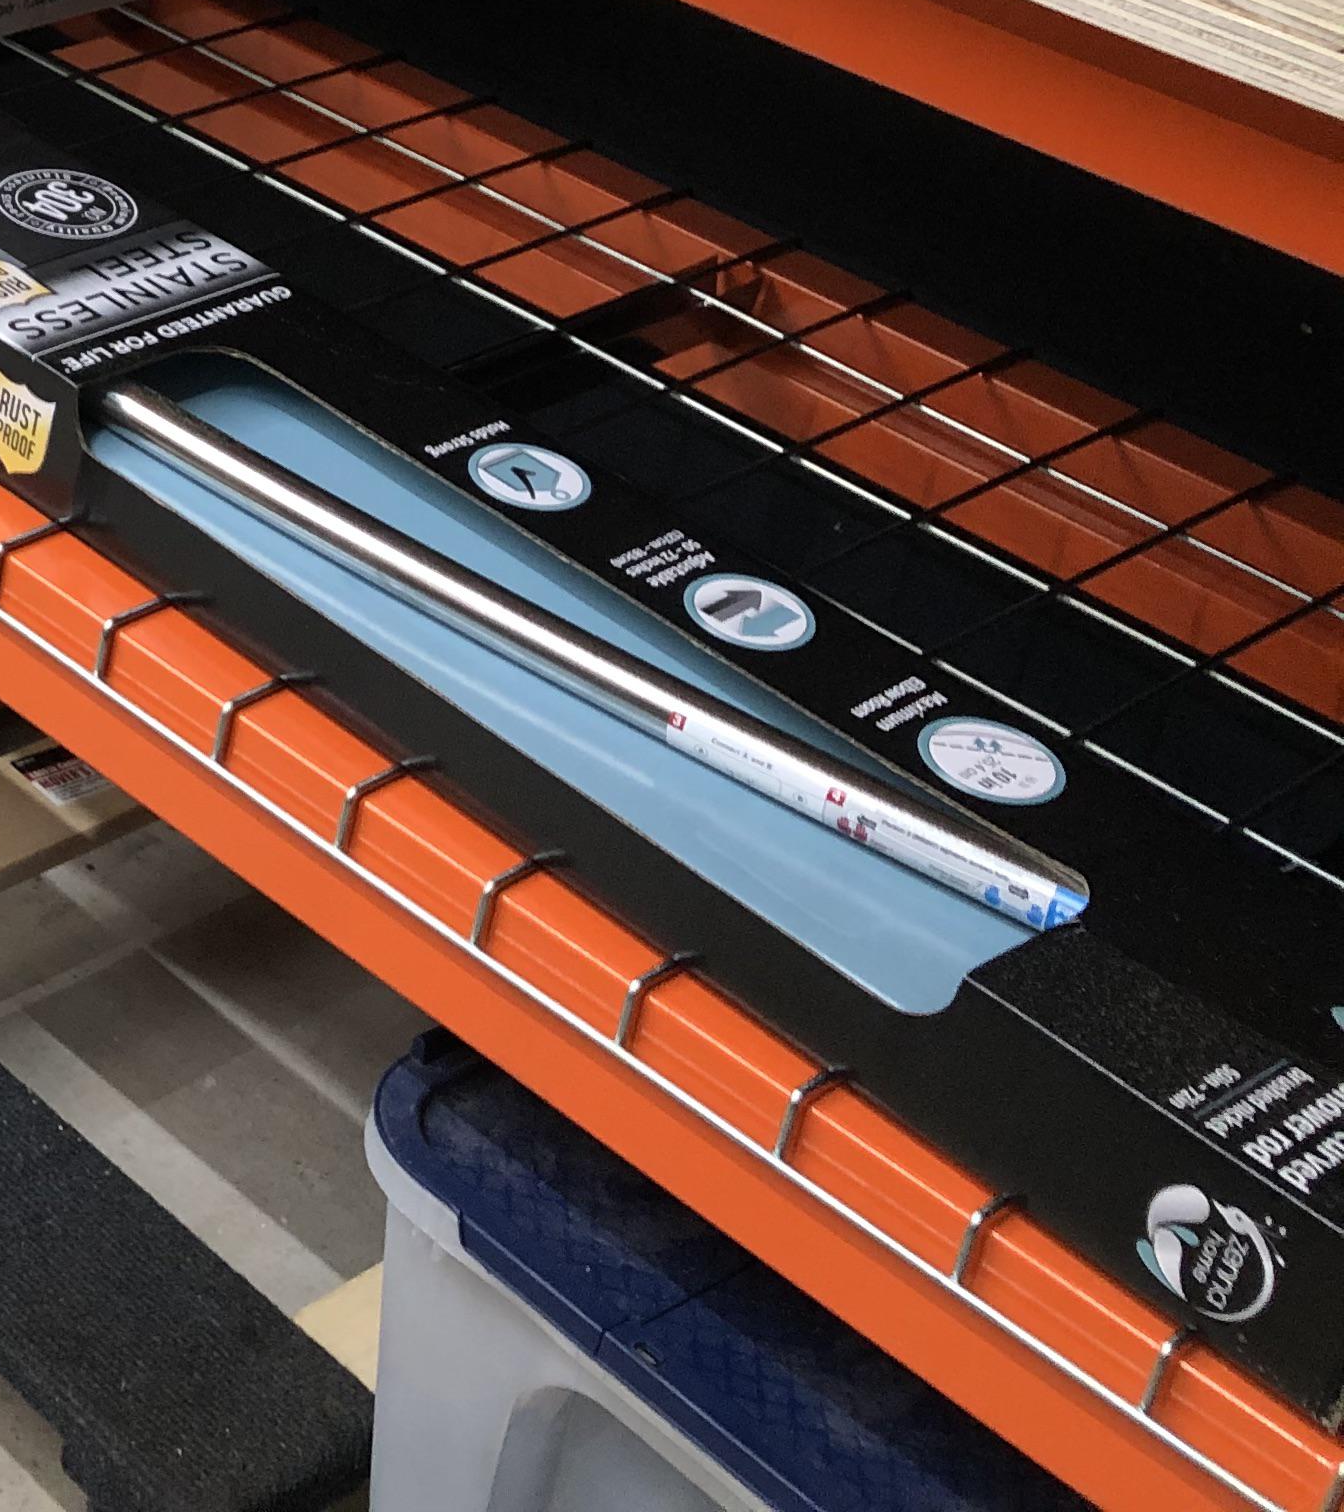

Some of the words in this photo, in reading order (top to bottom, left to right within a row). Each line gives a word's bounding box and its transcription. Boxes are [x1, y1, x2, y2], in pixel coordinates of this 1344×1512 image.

[22, 181, 95, 222] 304
[46, 223, 114, 236] Quality
[70, 230, 212, 281] STEEL
[7, 252, 248, 341] STAINLESS
[156, 285, 292, 338] GUARANTEED
[109, 330, 158, 355] FOR
[424, 434, 474, 458] Strong
[469, 420, 511, 440] Holds
[646, 550, 716, 588] Adjustable
[850, 693, 892, 719] Room
[883, 676, 927, 702] Elbow
[875, 690, 949, 732] Maximum
[992, 767, 1017, 785] 10
[1246, 1066, 1316, 1112] brushed
[1203, 1099, 1256, 1139] nickel
[1241, 1128, 1294, 1170] rod
[1193, 1228, 1228, 1284] home
[1206, 1232, 1250, 1311] zenna
